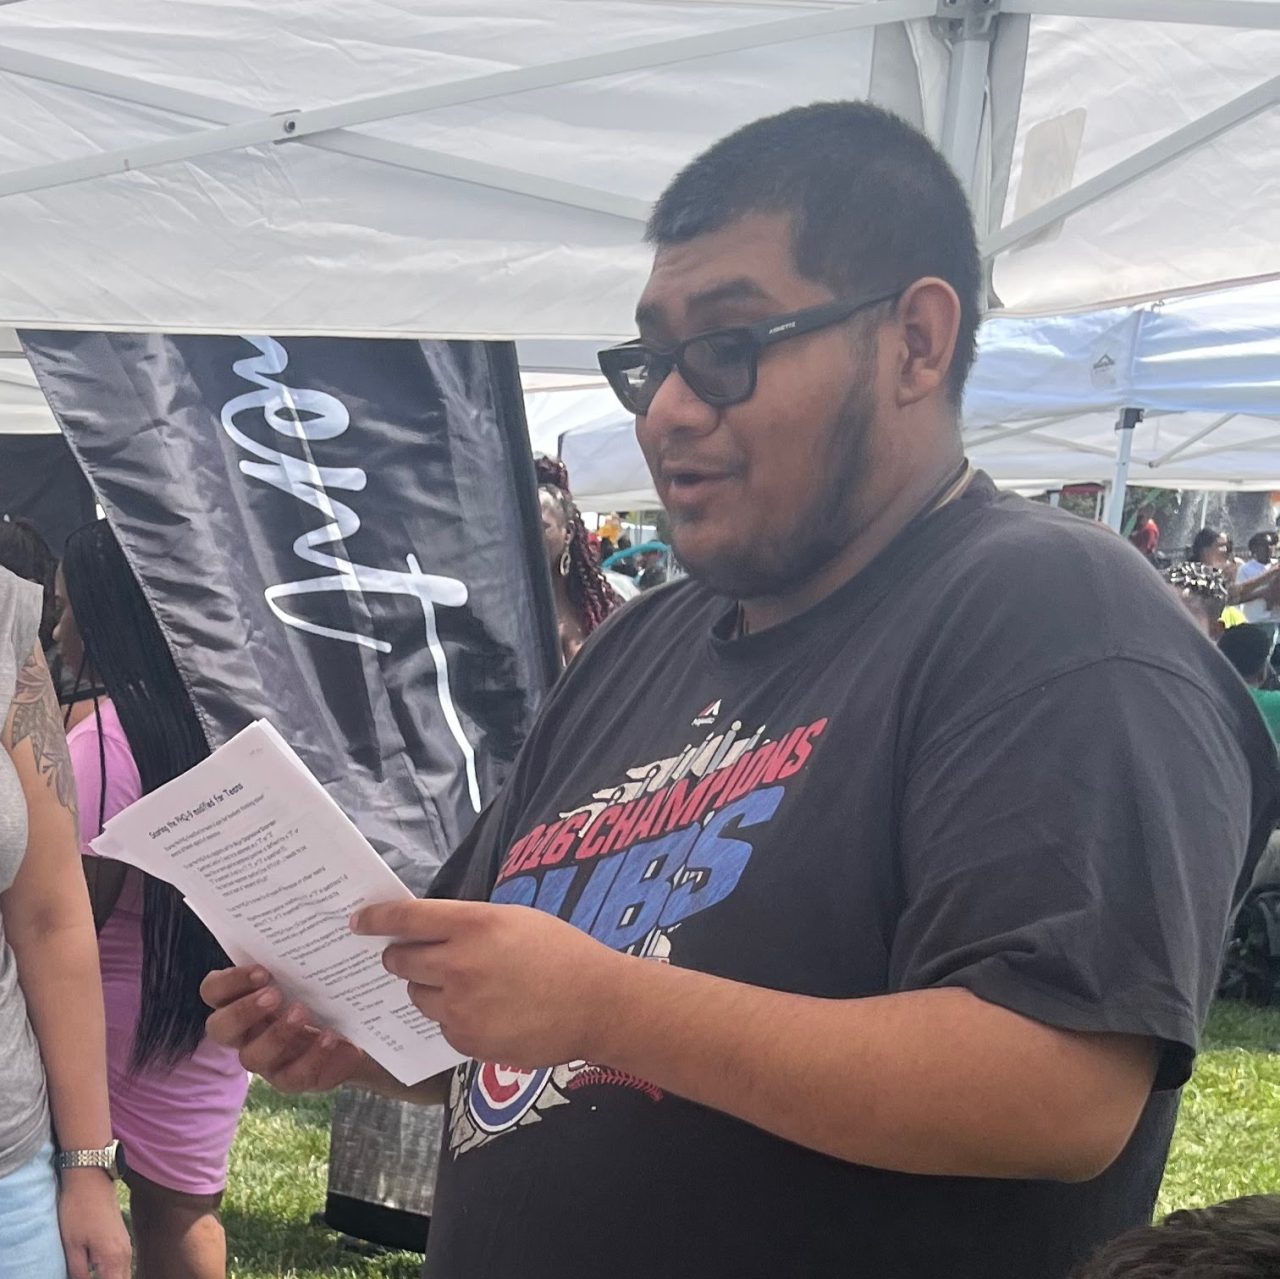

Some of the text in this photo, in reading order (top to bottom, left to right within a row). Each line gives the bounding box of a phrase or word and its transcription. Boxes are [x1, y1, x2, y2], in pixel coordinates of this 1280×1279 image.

[148, 823, 170, 841] Scoring
[166, 818, 177, 829] the
[213, 792, 225, 803] for
[223, 781, 244, 798] Teens
[496, 718, 827, 886] 2016 CHAMPIONS
